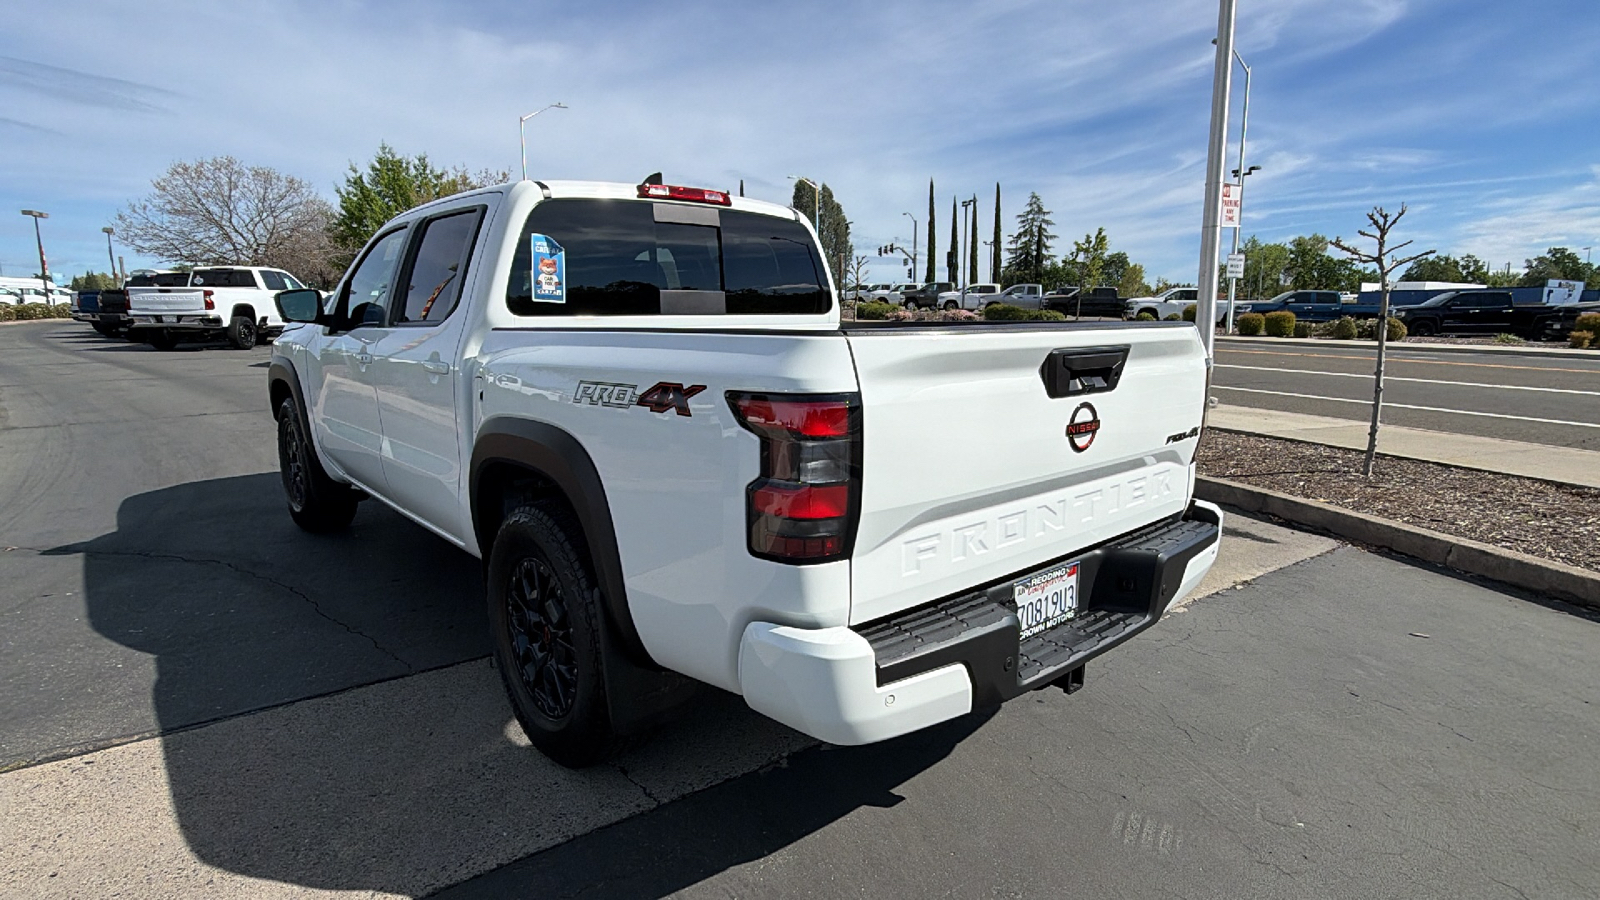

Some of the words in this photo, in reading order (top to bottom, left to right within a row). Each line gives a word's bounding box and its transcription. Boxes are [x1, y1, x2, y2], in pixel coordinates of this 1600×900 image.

[1068, 421, 1099, 434] NISSAN
[902, 468, 1172, 577] FRONTIER
[1031, 567, 1066, 586] REDDING
[1018, 585, 1075, 631] 70819U3
[1020, 623, 1046, 640] CROWN
[1046, 610, 1075, 629] MOTORS
